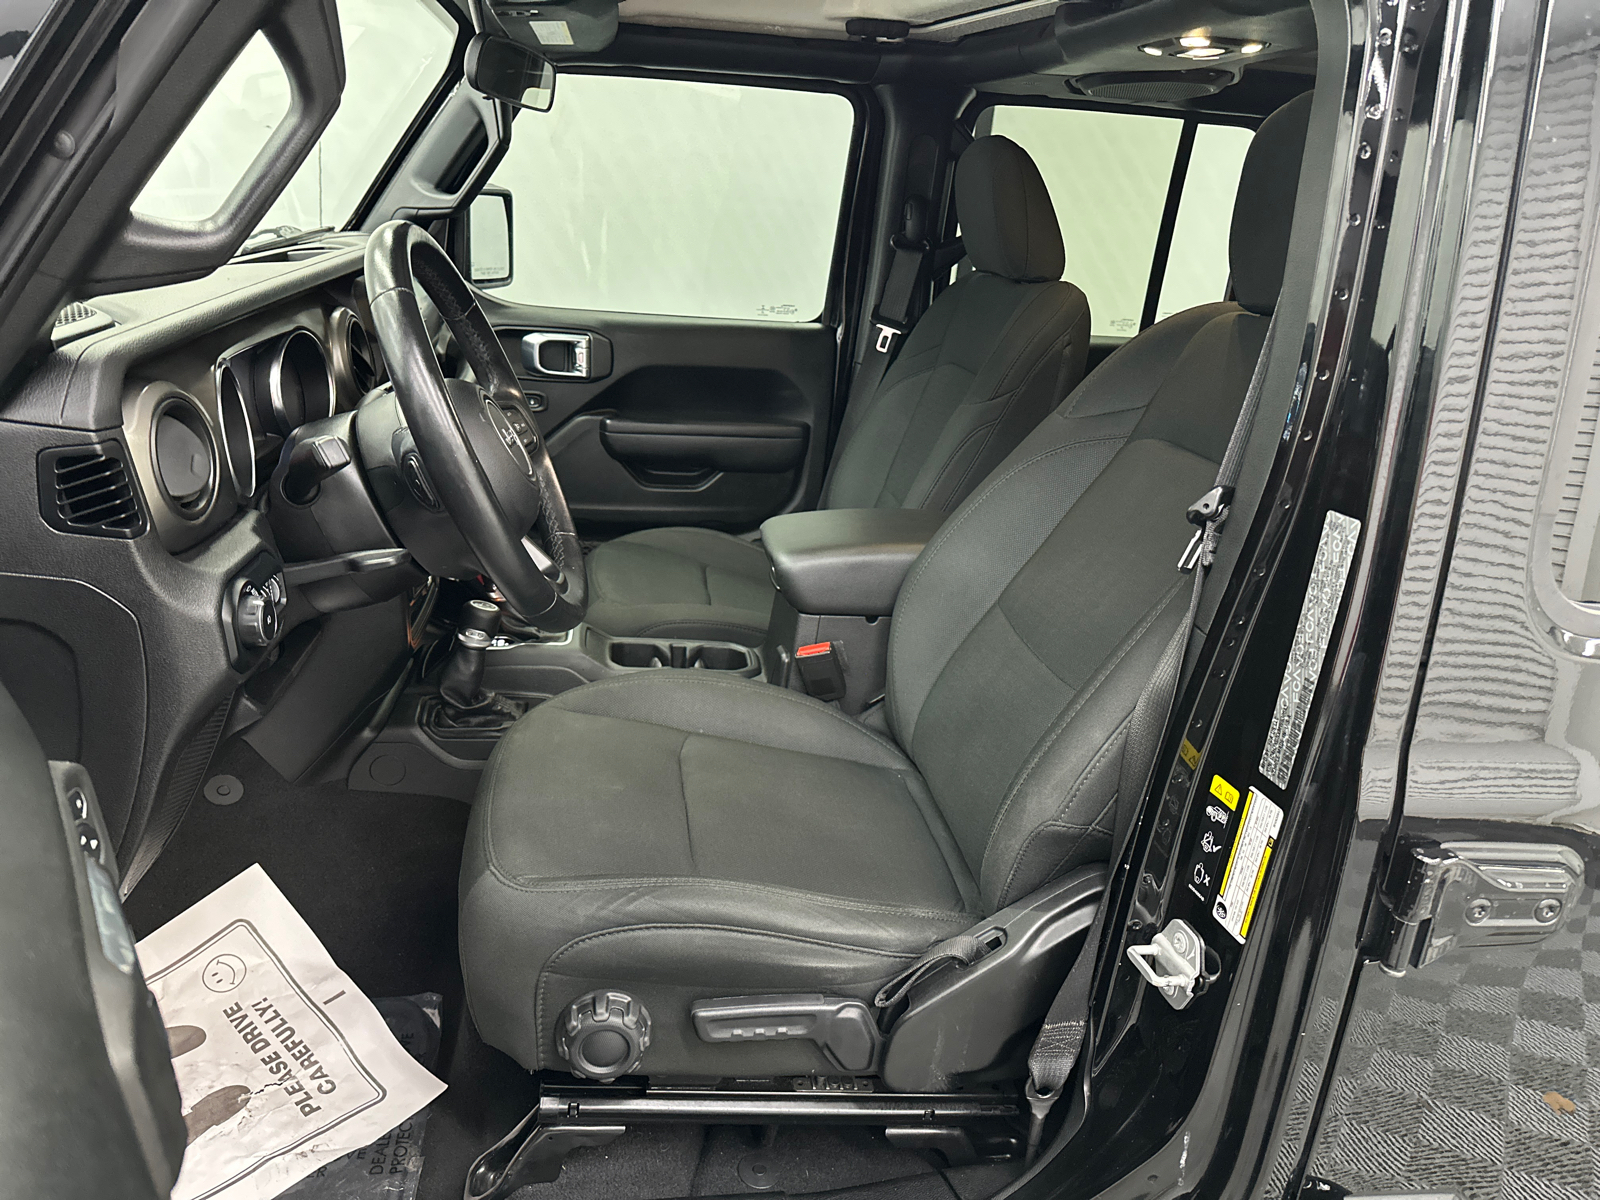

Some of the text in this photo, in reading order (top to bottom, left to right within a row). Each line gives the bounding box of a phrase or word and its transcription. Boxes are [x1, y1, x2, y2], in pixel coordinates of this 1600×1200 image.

[222, 1001, 321, 1117] PLEASE DRIVE
[251, 997, 337, 1094] CAREFULLY!
[369, 1131, 392, 1176] DEALE
[390, 1118, 414, 1175] PROTEC
